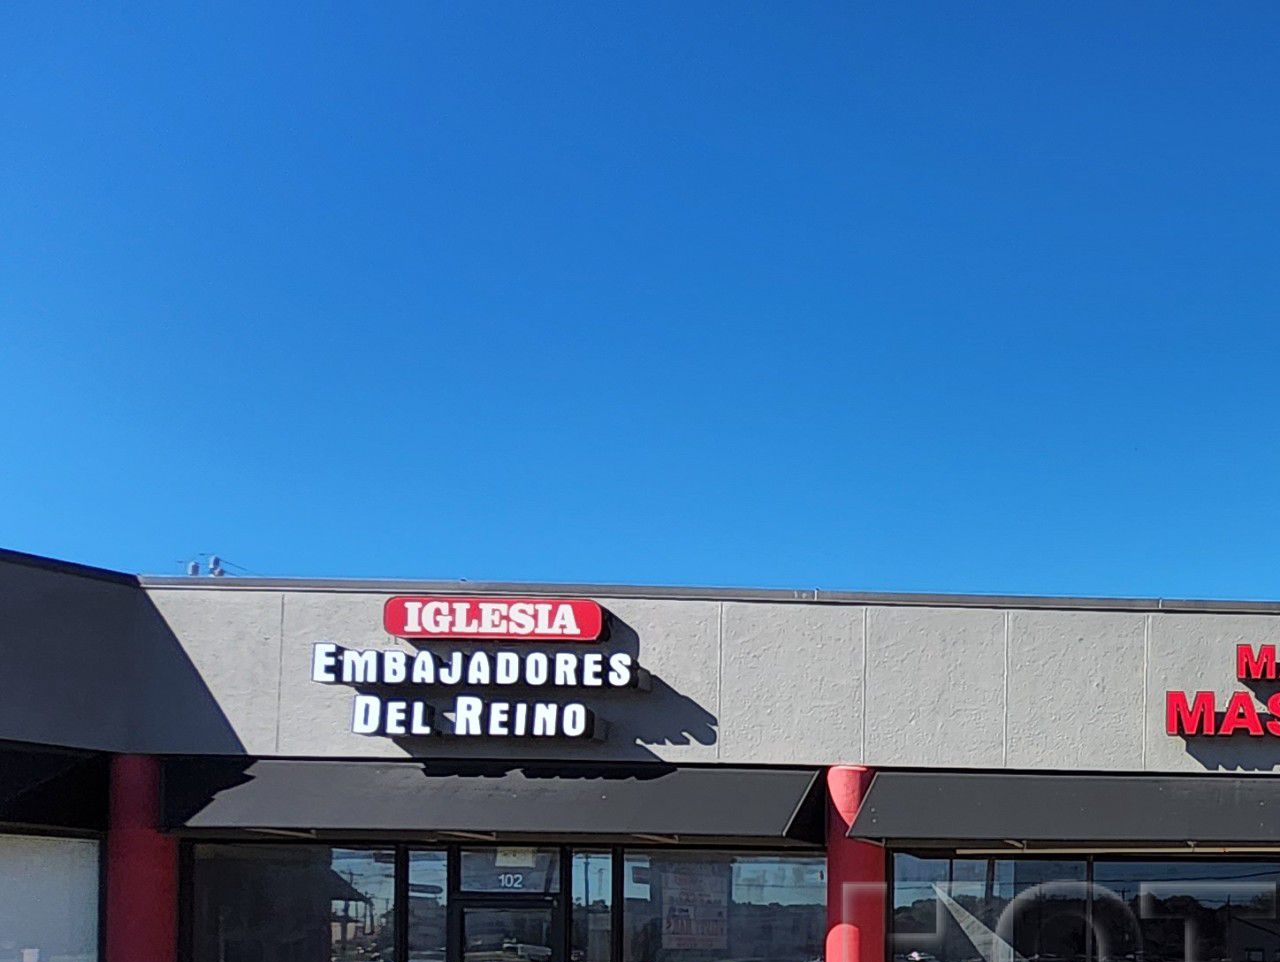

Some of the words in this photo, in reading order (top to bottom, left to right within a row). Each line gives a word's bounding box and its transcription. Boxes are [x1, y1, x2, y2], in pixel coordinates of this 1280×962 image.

[403, 601, 580, 636] IGLESIA
[312, 642, 632, 687] EMBAJADORES
[352, 694, 431, 735] DEL
[454, 696, 587, 737] REINO
[498, 873, 523, 888] 102
